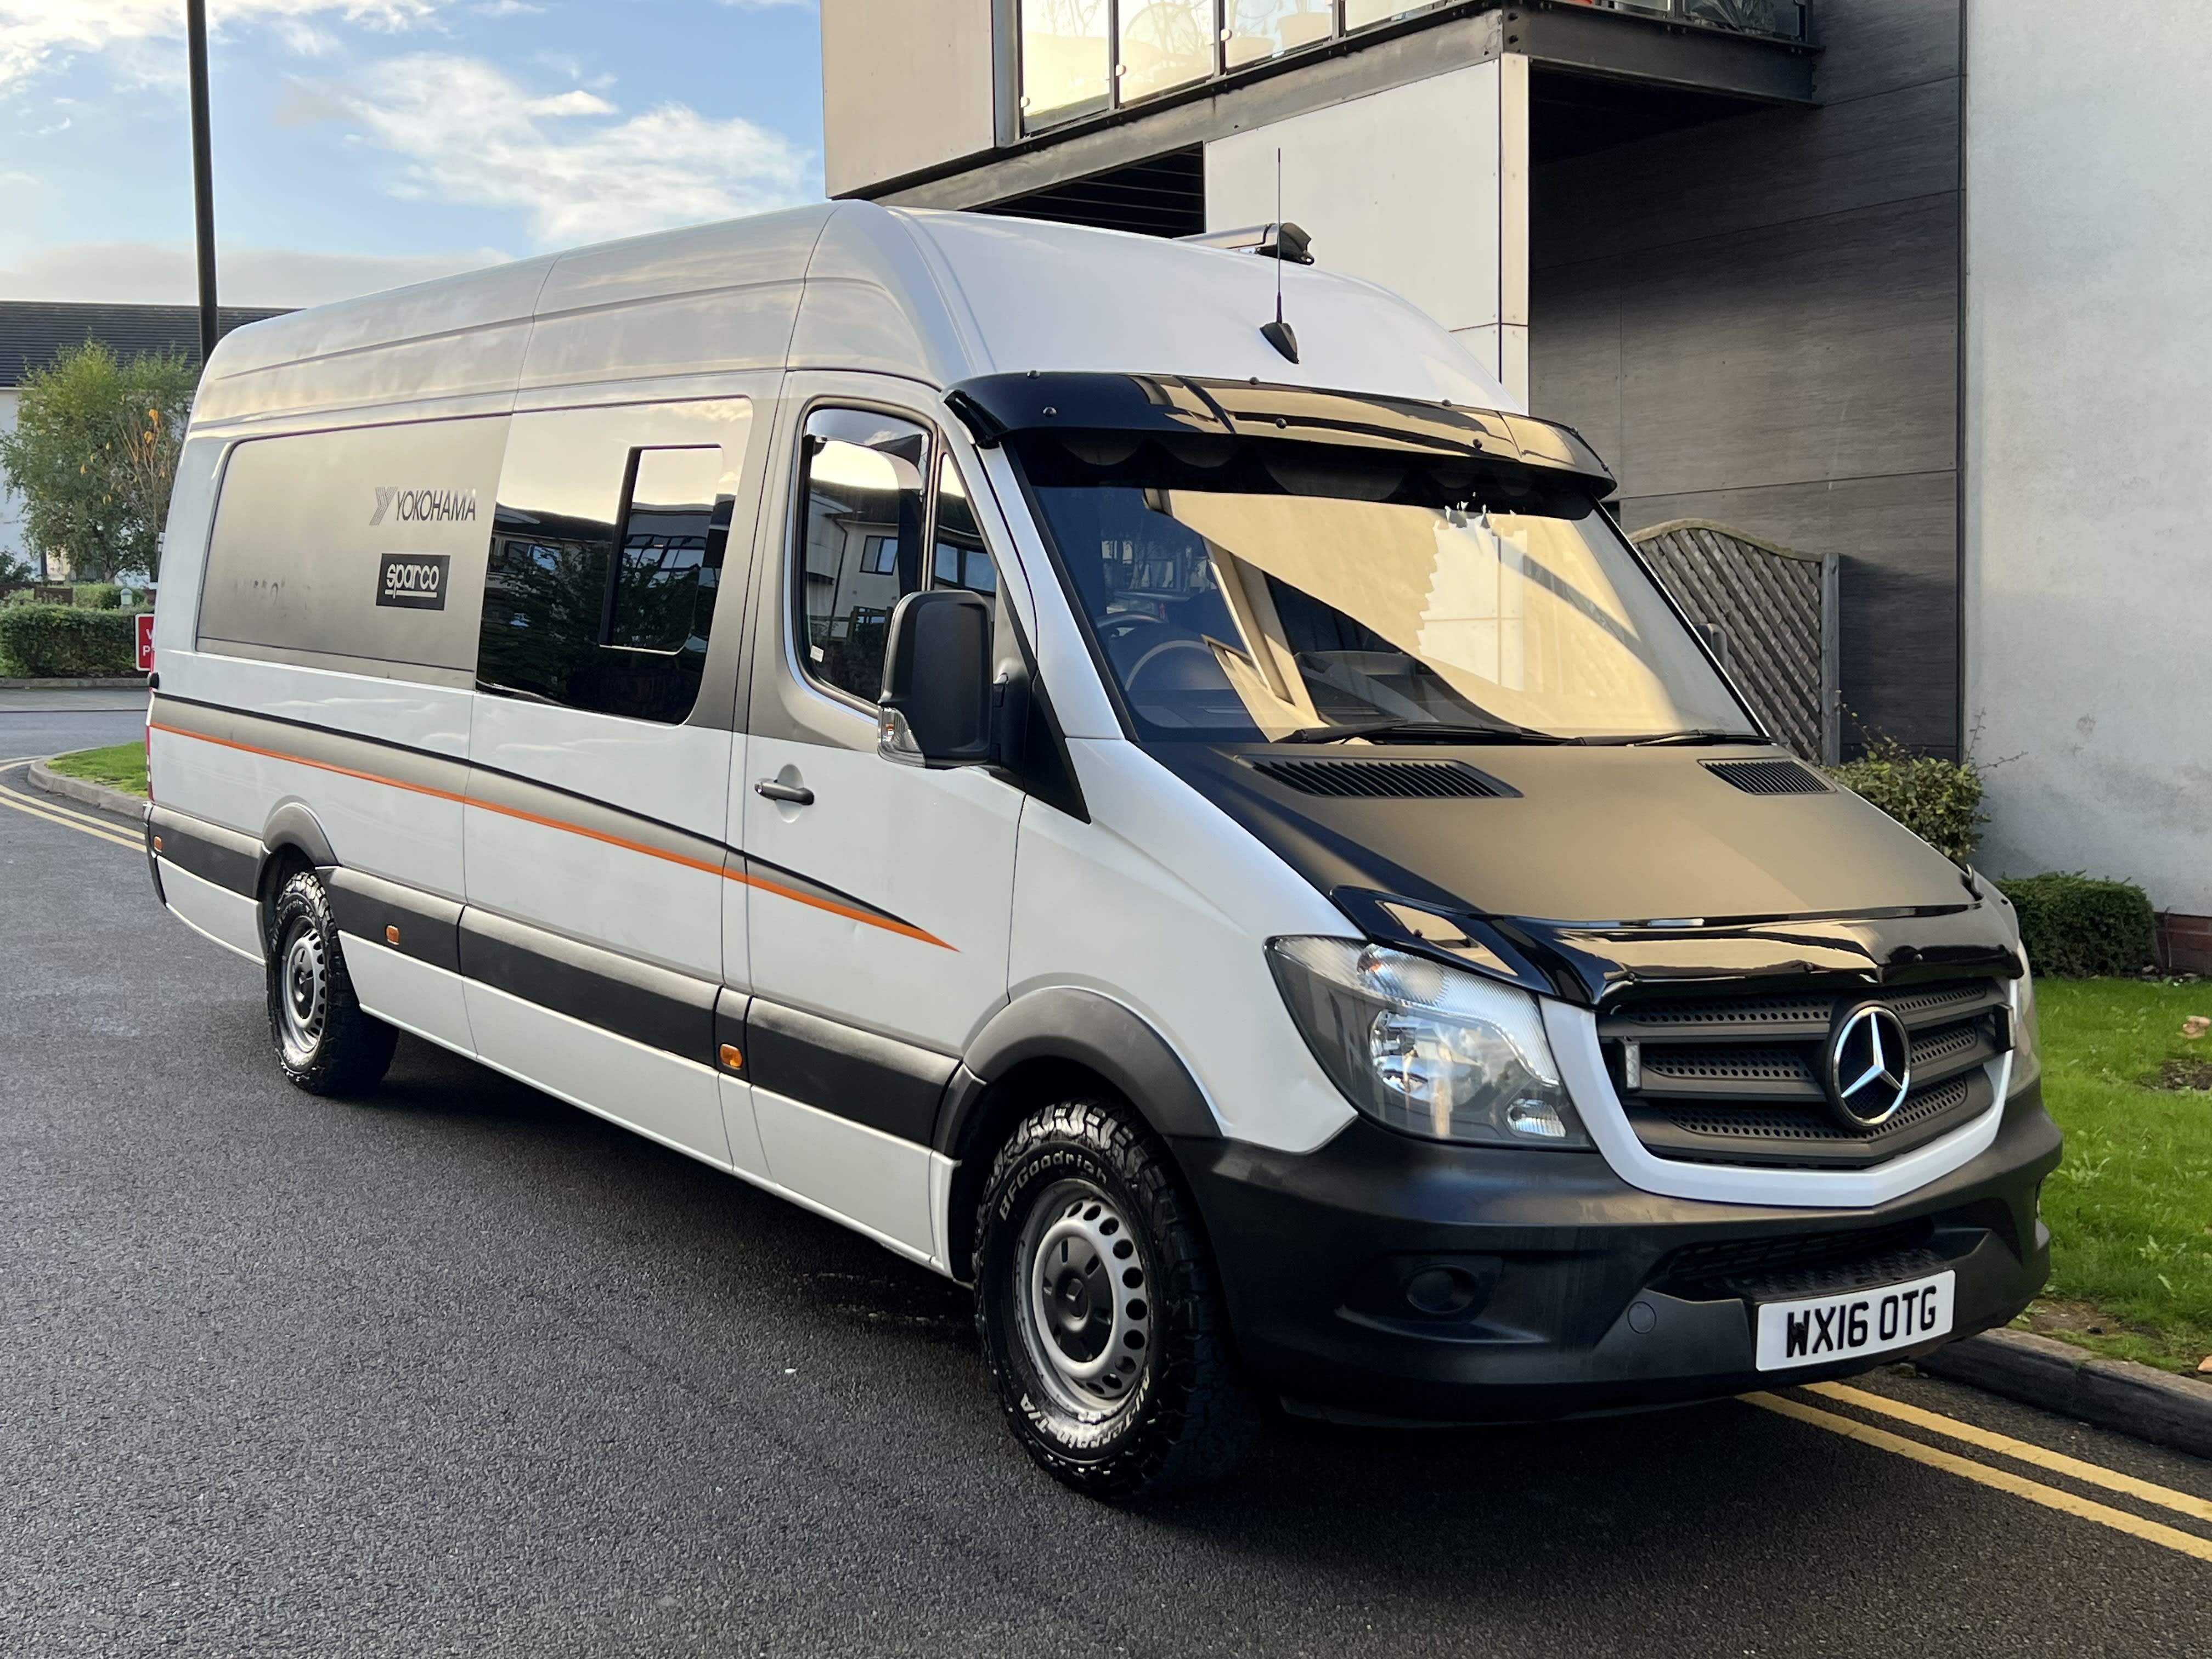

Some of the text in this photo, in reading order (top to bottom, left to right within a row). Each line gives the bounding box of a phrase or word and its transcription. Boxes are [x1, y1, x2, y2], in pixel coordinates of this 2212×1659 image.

[396, 489, 476, 521] YOKOHAMA
[386, 563, 439, 599] sparco
[999, 1150, 1107, 1222] BFGoodrich
[1786, 1285, 1937, 1358] WX16 OTG
